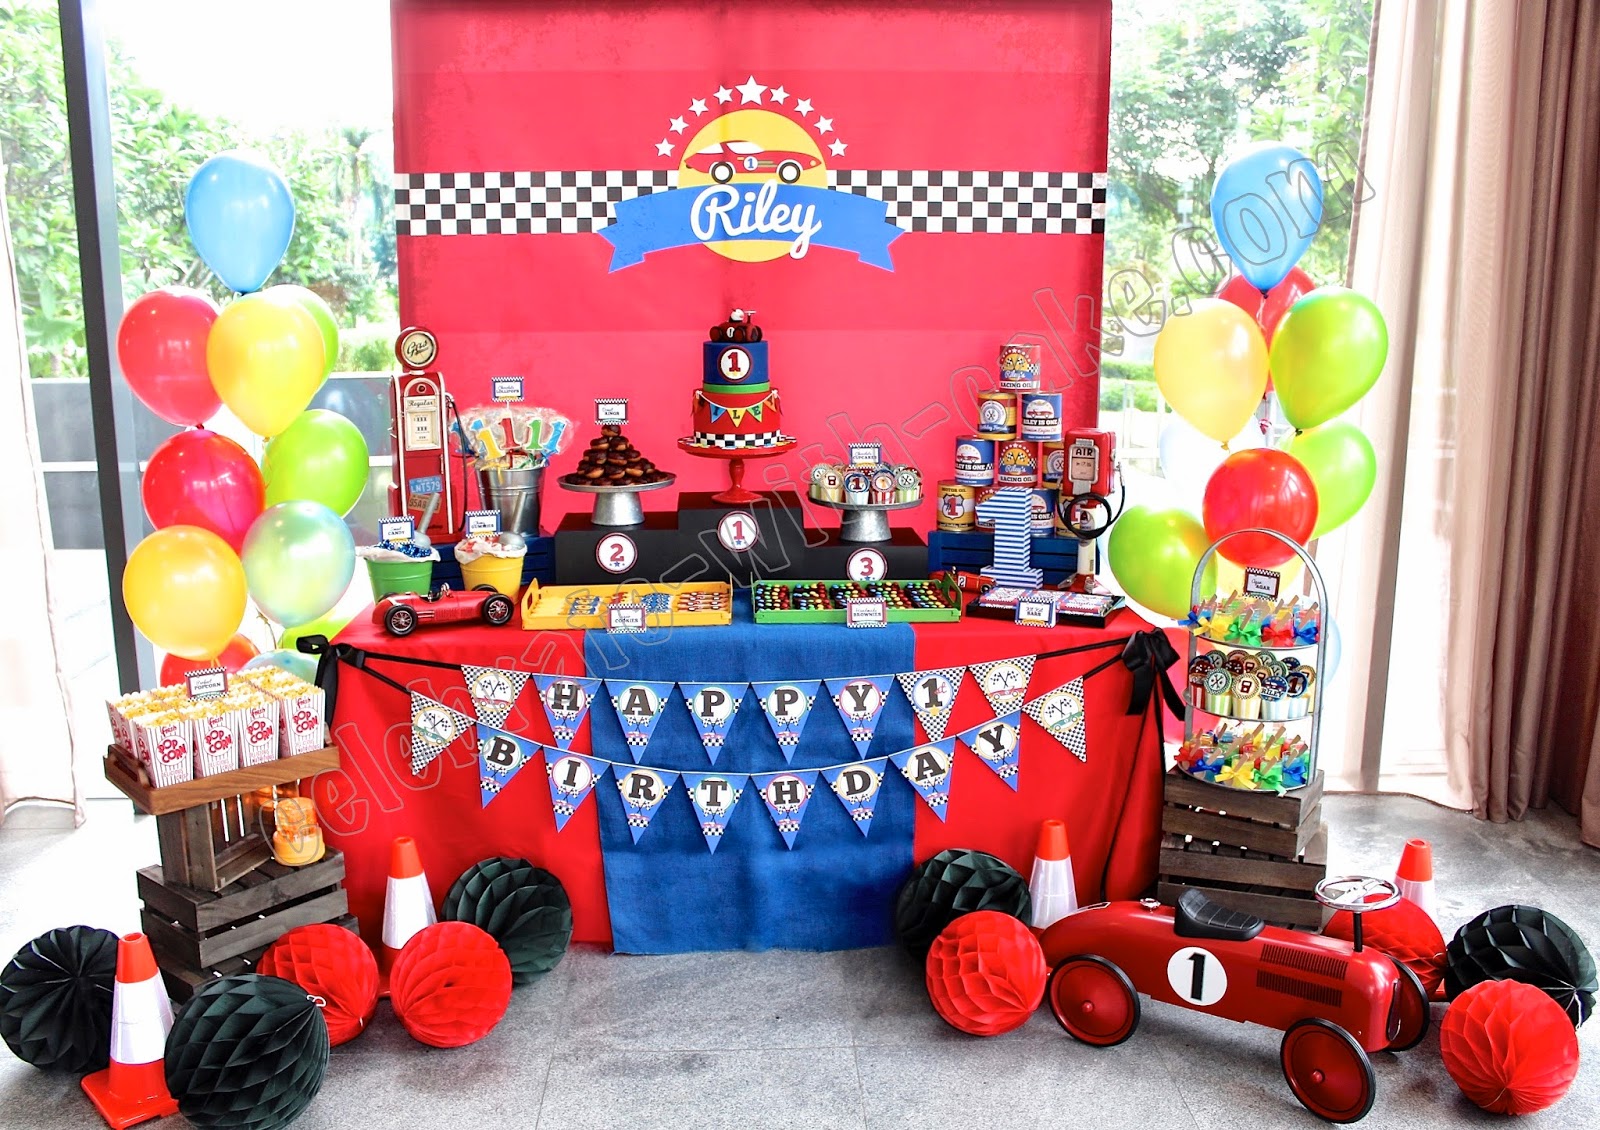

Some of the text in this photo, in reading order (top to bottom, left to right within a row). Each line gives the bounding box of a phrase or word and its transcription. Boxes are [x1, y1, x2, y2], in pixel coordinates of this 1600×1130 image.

[690, 179, 822, 260] Riley
[727, 351, 741, 372] 1
[409, 399, 434, 407] Regular
[1075, 448, 1093, 457] AIR
[1004, 465, 1026, 474] Riley's
[731, 520, 745, 540] 1
[609, 543, 625, 562] 2
[859, 557, 874, 577] 3
[1261, 687, 1285, 698] RILEY
[292, 711, 311, 725] POP
[296, 715, 318, 733] CORN
[246, 721, 266, 735] POP
[250, 725, 273, 743] CORN
[157, 739, 178, 754] POP
[205, 730, 224, 745] POP
[209, 734, 232, 753] CORN
[162, 744, 187, 763] CORN
[486, 723, 1006, 808] BIRTHDAY
[1187, 952, 1206, 1001] 1
